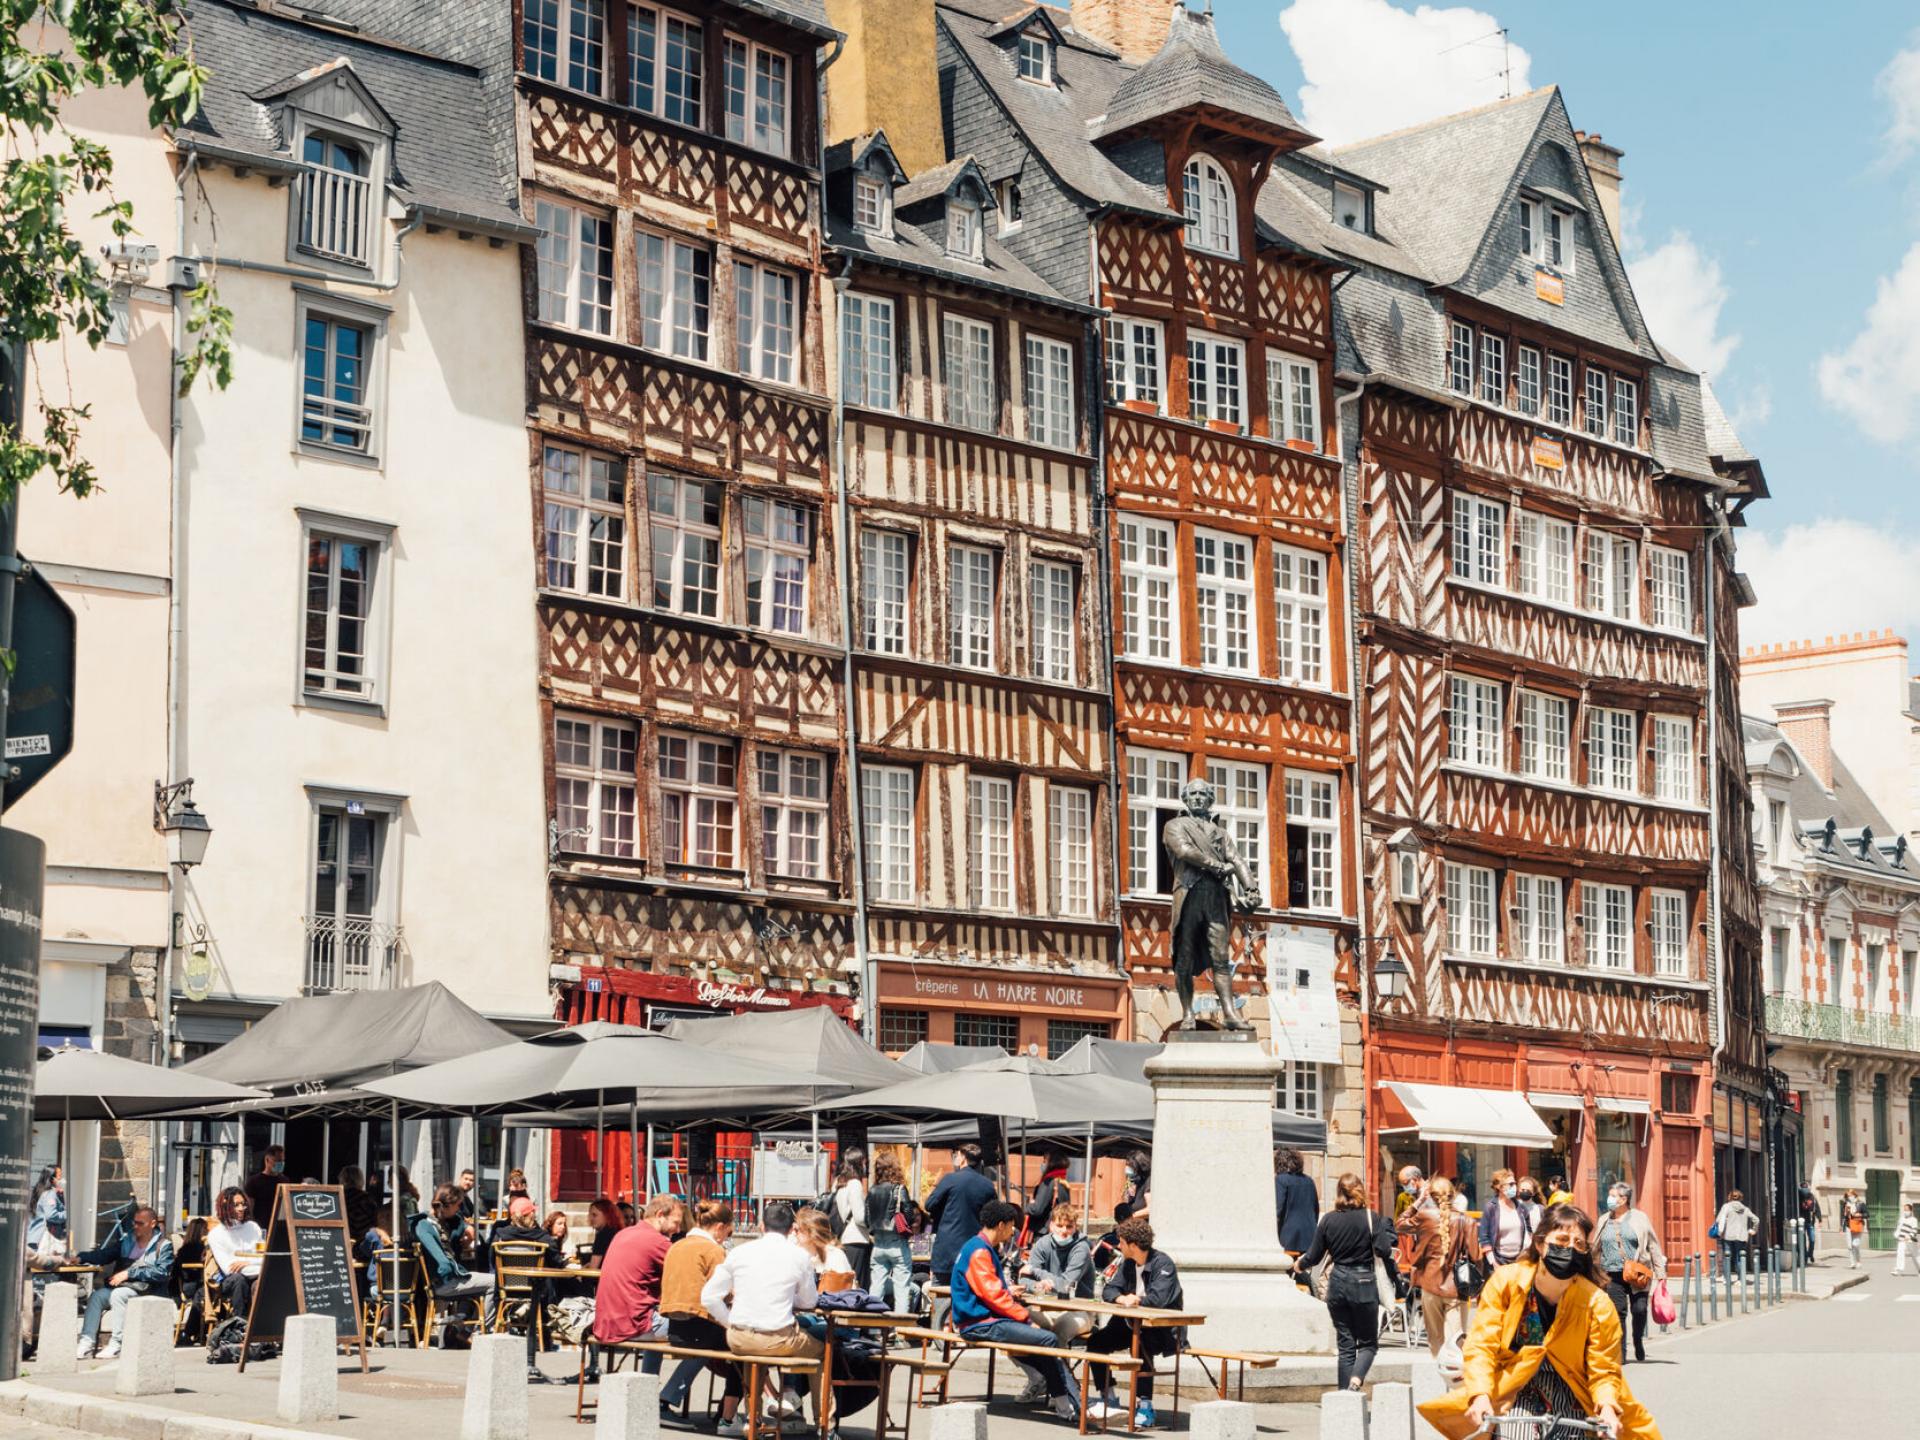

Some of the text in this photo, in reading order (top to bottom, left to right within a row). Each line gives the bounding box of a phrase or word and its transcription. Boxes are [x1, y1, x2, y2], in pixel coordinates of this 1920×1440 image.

[747, 988, 791, 1006] Maman
[916, 980, 1083, 1005] crêperie LA HARPE NOIRE
